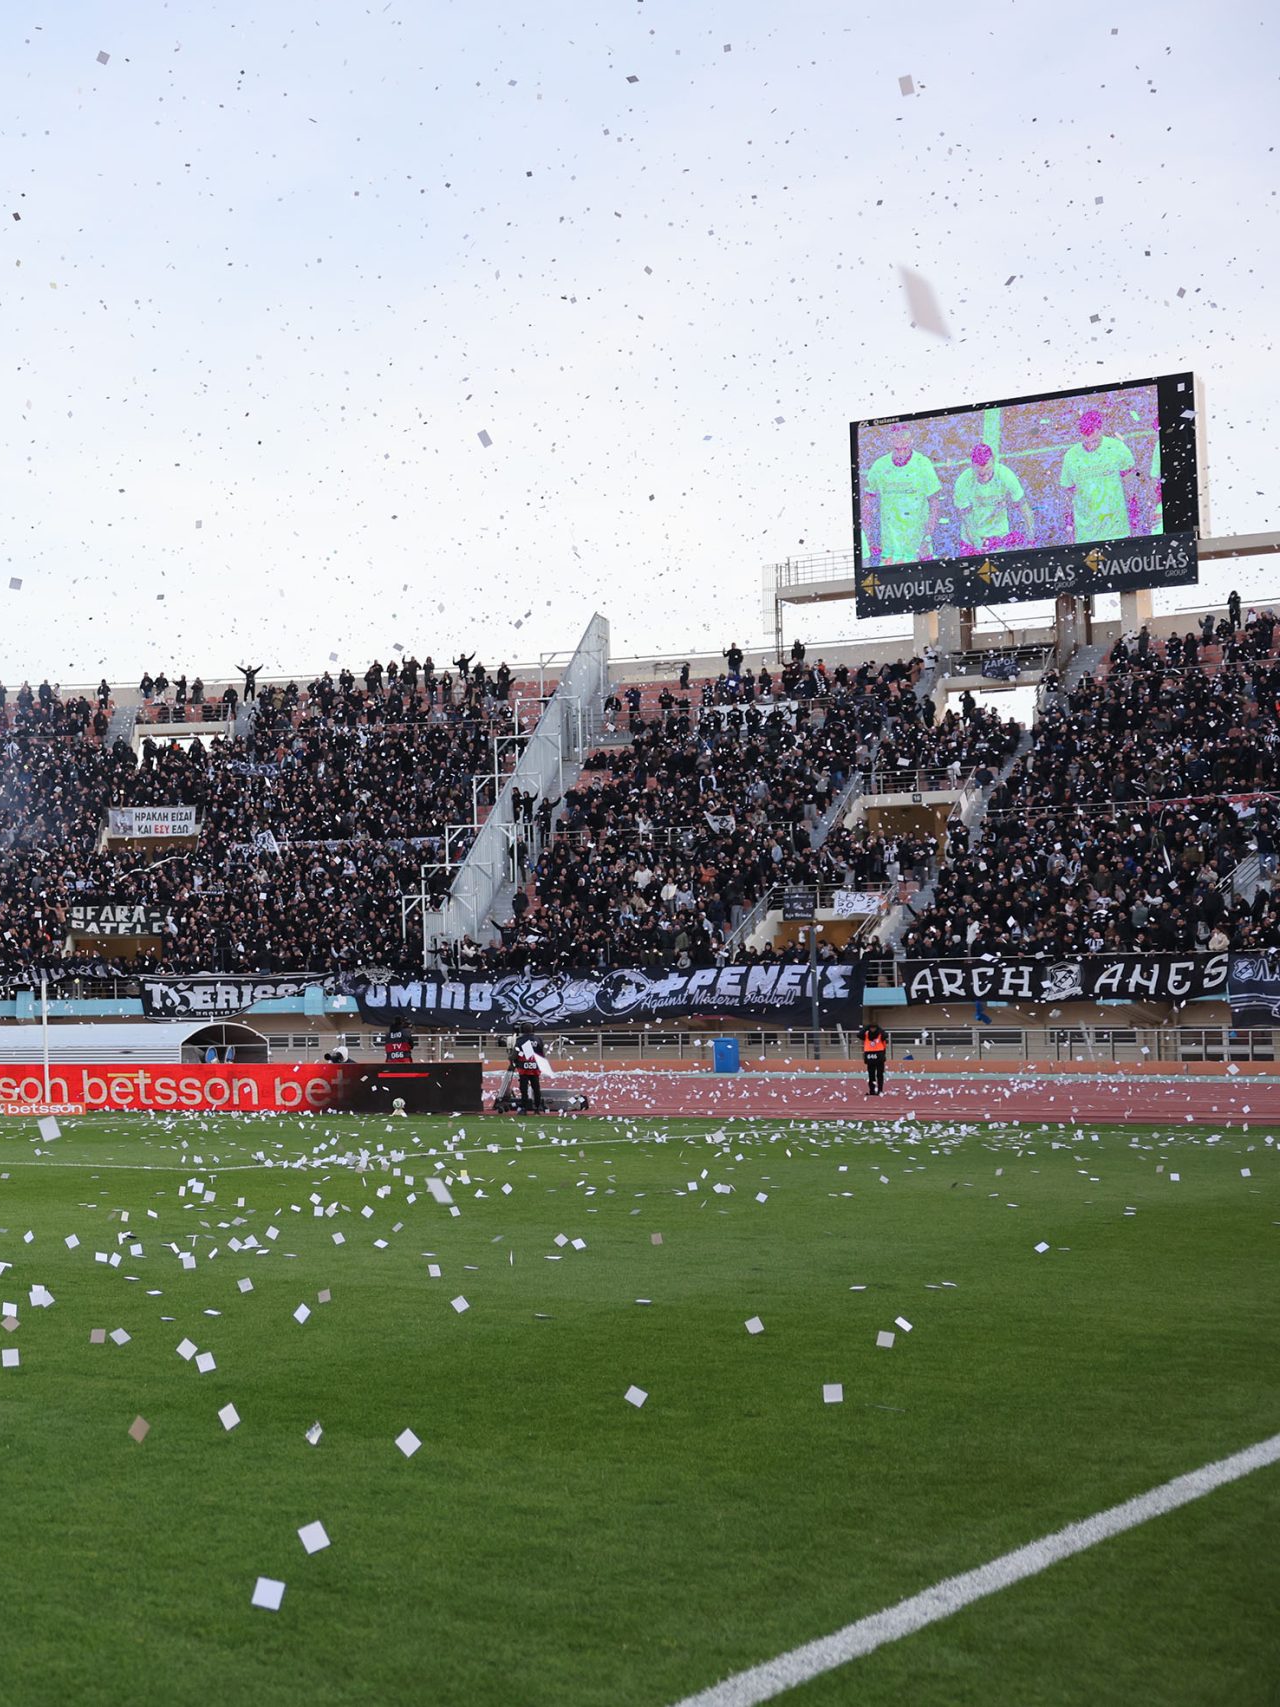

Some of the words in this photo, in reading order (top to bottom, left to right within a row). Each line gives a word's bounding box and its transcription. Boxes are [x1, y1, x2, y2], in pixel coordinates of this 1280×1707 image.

[1098, 552, 1188, 576] VAVOULAS
[991, 565, 1076, 588] VAVOULAS
[875, 578, 955, 600] VAVOULAS
[135, 812, 168, 821] ΗΡΑΚΛΗ
[170, 811, 192, 821] ΕΙΣΑΙ
[138, 825, 152, 834] ΚΑΙ
[154, 824, 170, 834] ΕΣΥ
[172, 824, 188, 833] ΕΔΩ
[910, 966, 1033, 999] ARCH
[640, 989, 689, 1013] Against
[692, 989, 740, 1007] Modern
[744, 987, 797, 1006] Football
[82, 1069, 260, 1106] betsson
[8, 1103, 83, 1115] betsson
